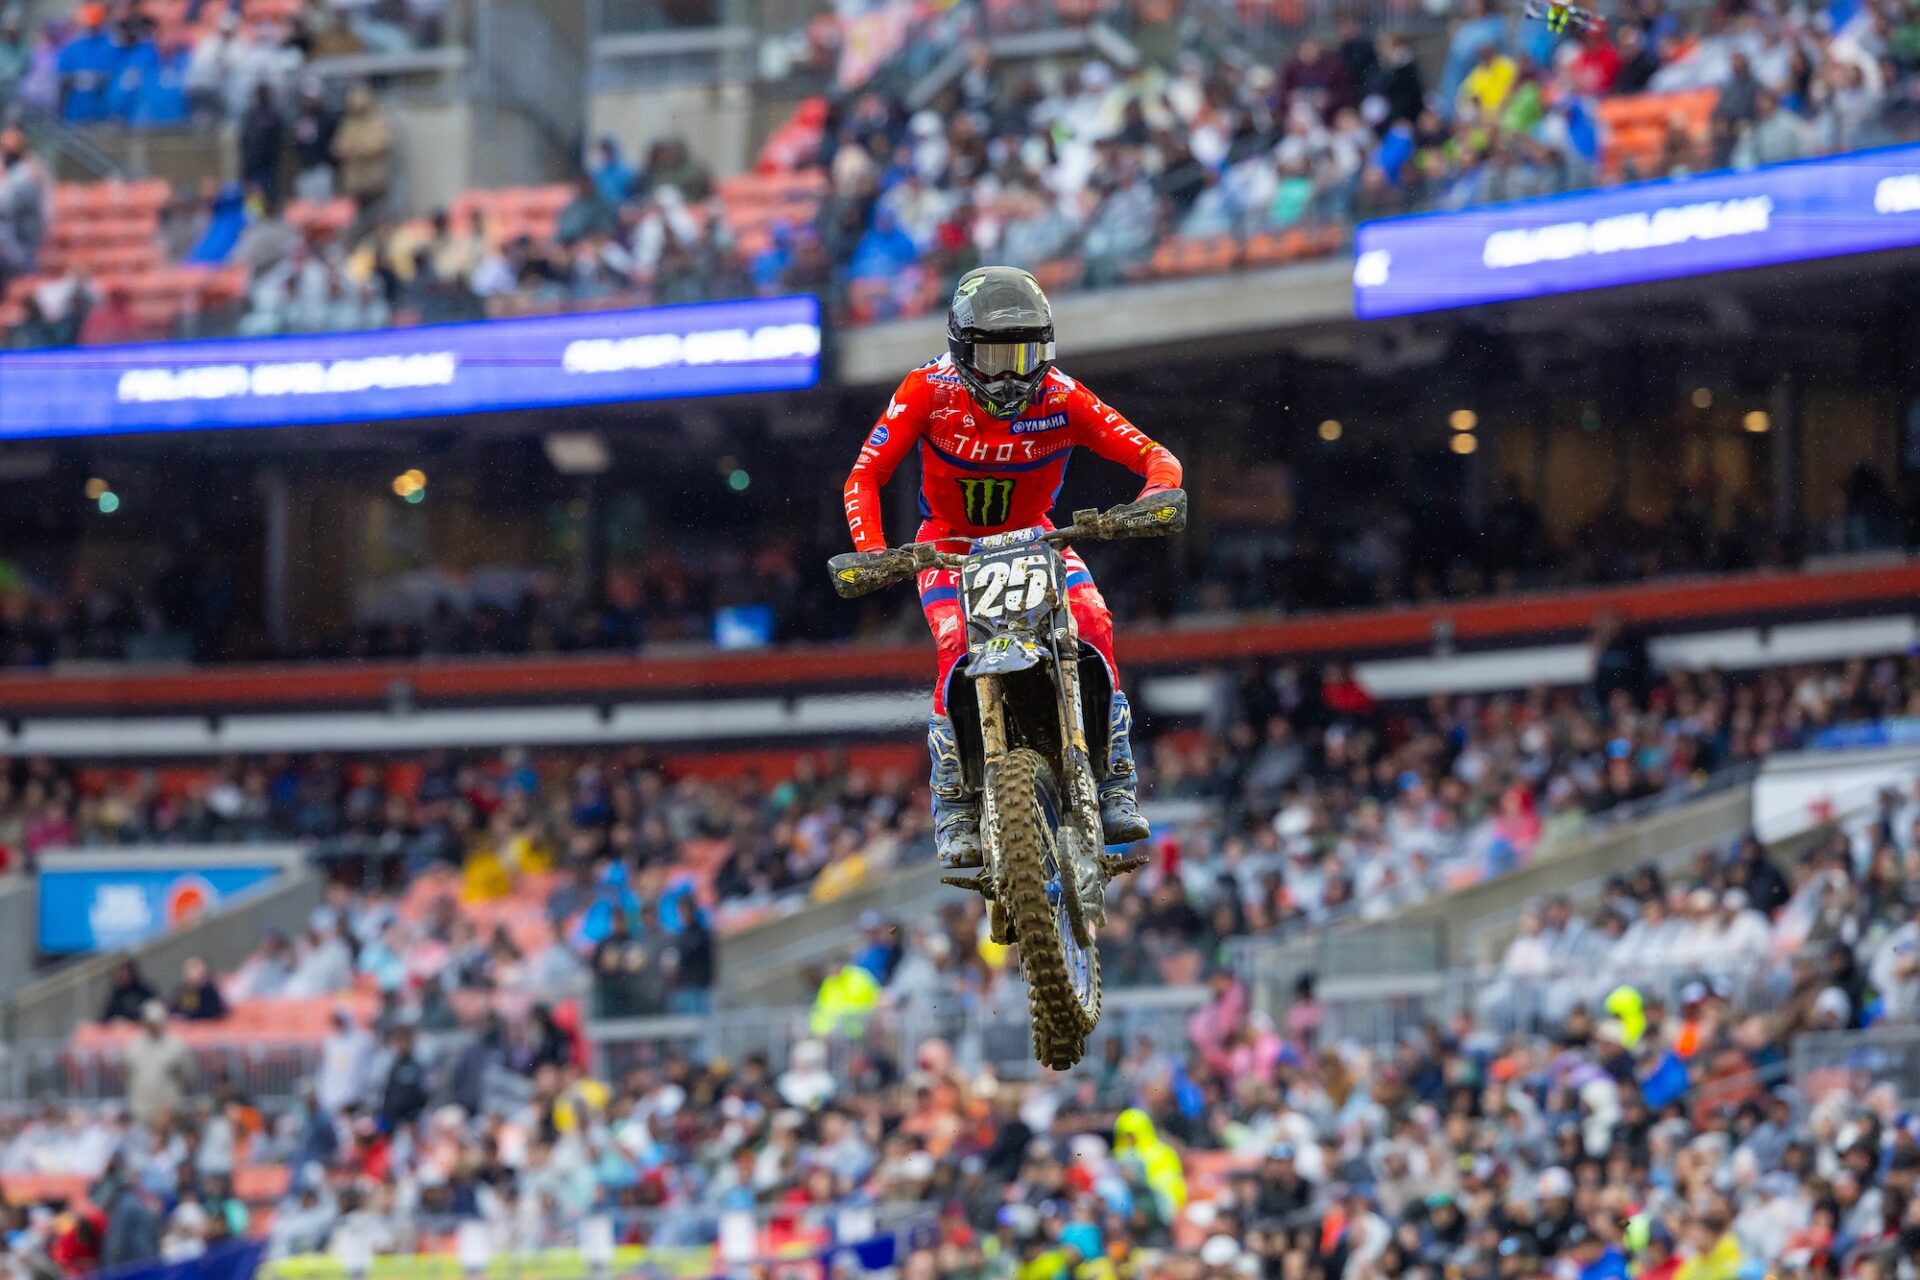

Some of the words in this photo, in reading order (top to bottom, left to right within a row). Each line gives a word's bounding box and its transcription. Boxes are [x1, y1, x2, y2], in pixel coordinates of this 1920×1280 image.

[1025, 414, 1066, 432] YAMAHA
[953, 434, 1035, 461] THOR
[971, 554, 1049, 618] 25
